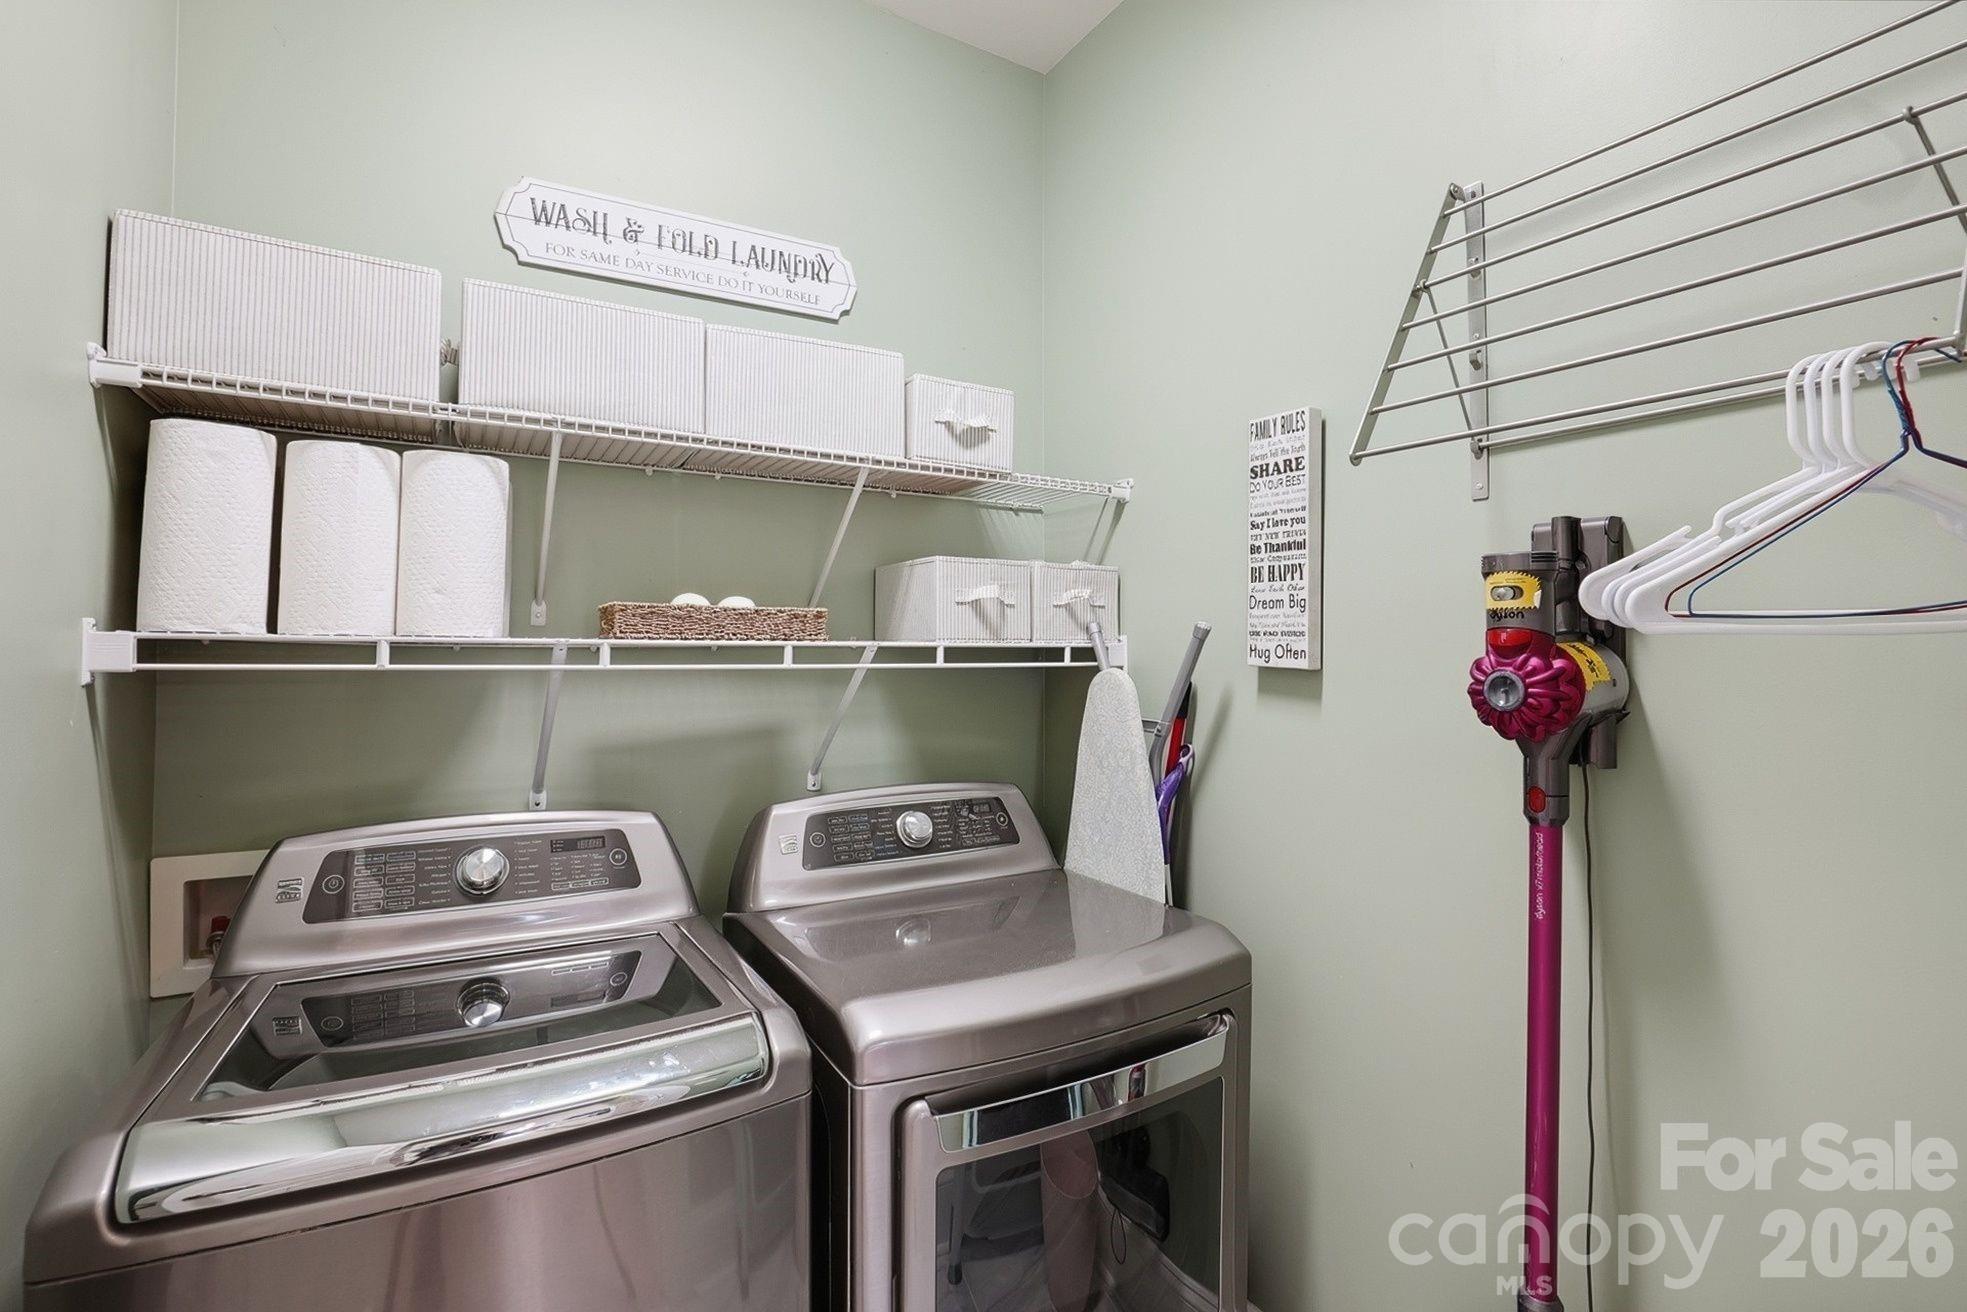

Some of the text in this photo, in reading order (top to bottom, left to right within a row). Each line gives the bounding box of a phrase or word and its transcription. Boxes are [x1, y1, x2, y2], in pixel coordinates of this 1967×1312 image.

[530, 197, 835, 285] WASH & FOLD LAUNDRY
[545, 242, 822, 306] FOR SAME DAY SERVICE DO IT YOURSELF
[1250, 410, 1306, 442] FAMILY RULES
[1249, 456, 1306, 480] SHARE
[1249, 481, 1261, 494] DO
[1262, 478, 1284, 490] YOUR
[1285, 473, 1306, 488] BEST
[1250, 520, 1265, 532] Say
[1266, 518, 1271, 529] I
[1290, 516, 1306, 528] you
[1250, 538, 1307, 555] Be Thankful
[1250, 563, 1306, 583] BE HAPPY
[1249, 593, 1307, 614] Dream Big
[1249, 643, 1307, 664] Hug Often
